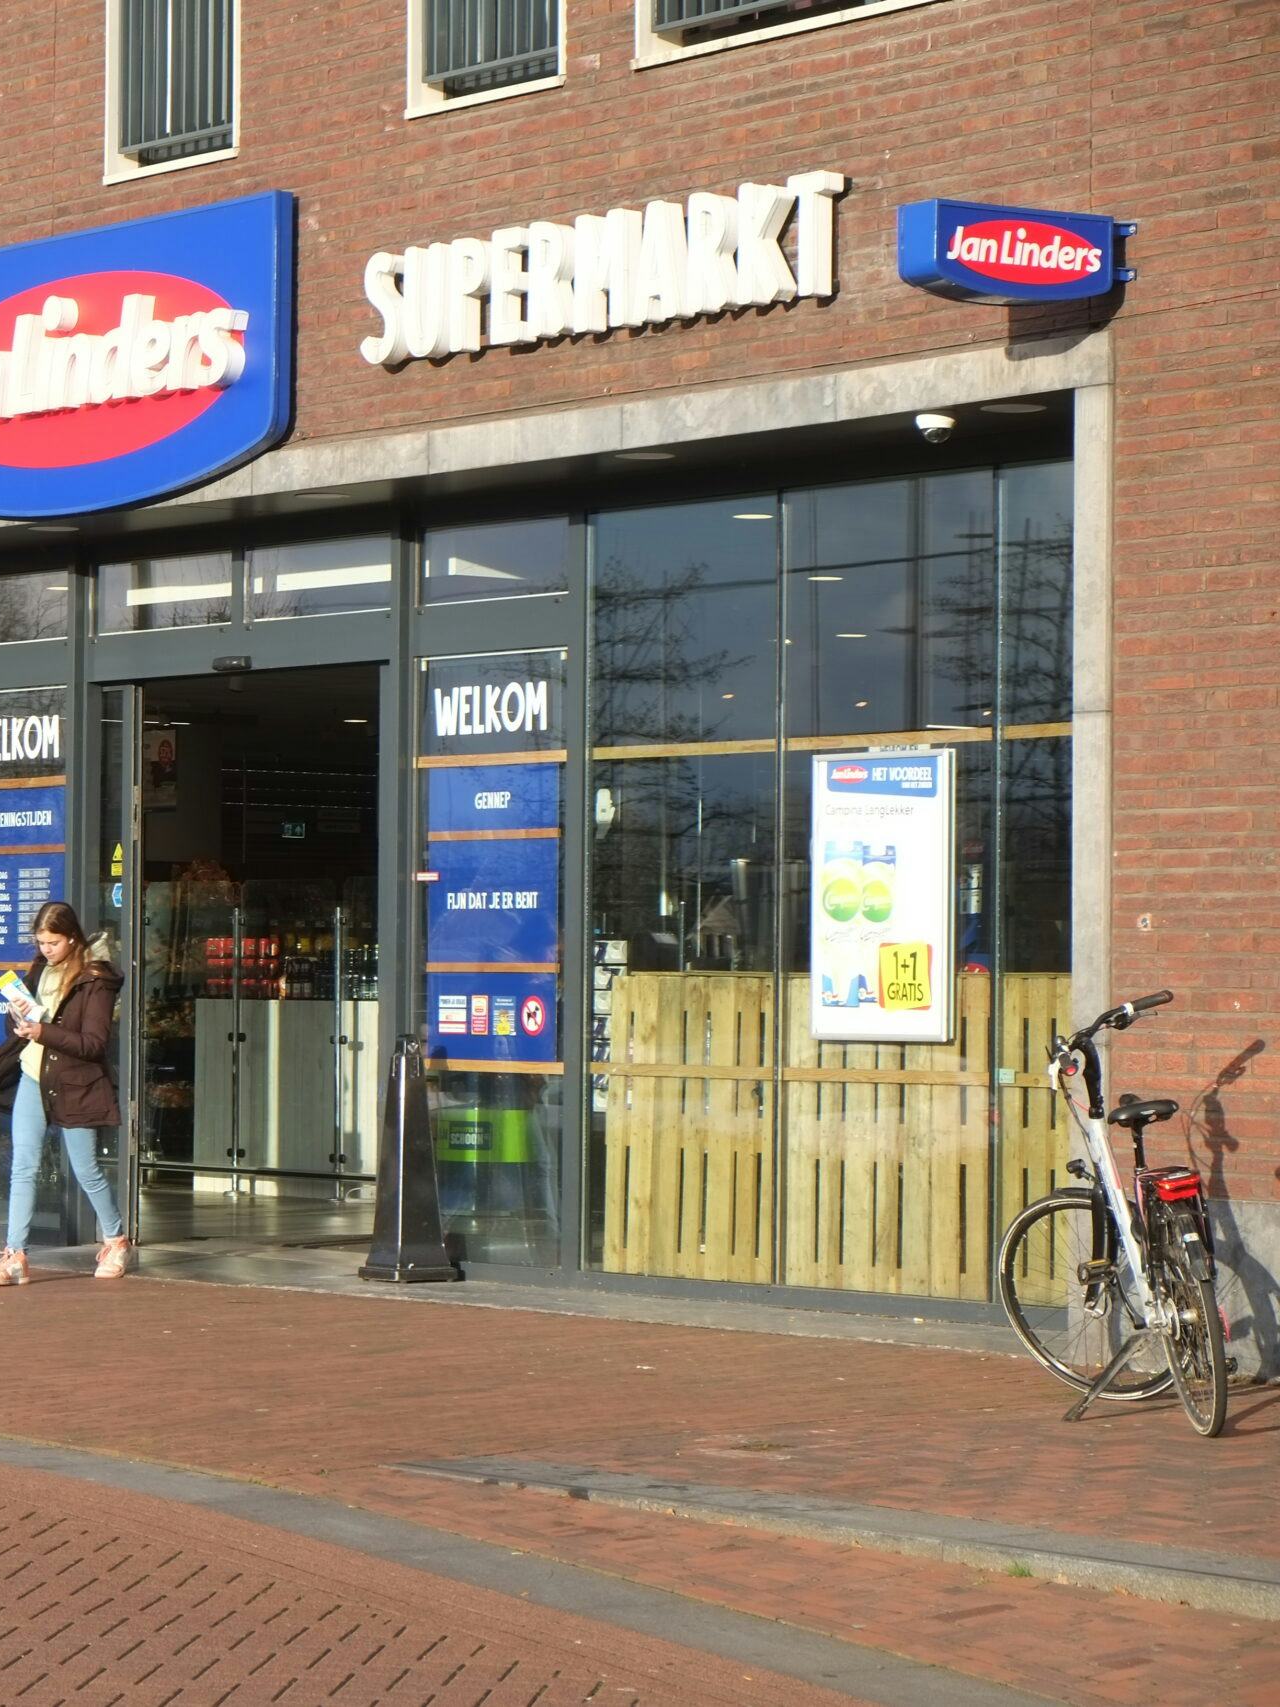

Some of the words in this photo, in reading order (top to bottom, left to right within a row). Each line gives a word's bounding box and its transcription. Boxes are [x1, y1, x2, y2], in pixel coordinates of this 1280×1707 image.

[947, 226, 997, 264] Jan
[1000, 228, 1102, 273] Linders
[361, 170, 845, 365] SUPERMARKT
[12, 293, 249, 415] Linders
[434, 681, 547, 736] WELKOM
[872, 767, 888, 782] HET
[889, 766, 933, 781] VOORDEEL
[474, 791, 511, 809] GENNEP
[447, 892, 466, 910] FIJN
[468, 892, 487, 909] DAT
[489, 892, 500, 909] JE
[502, 892, 513, 909] ER
[515, 891, 538, 909] BENT
[893, 951, 917, 981] 1+1
[887, 982, 924, 1002] GRATIS
